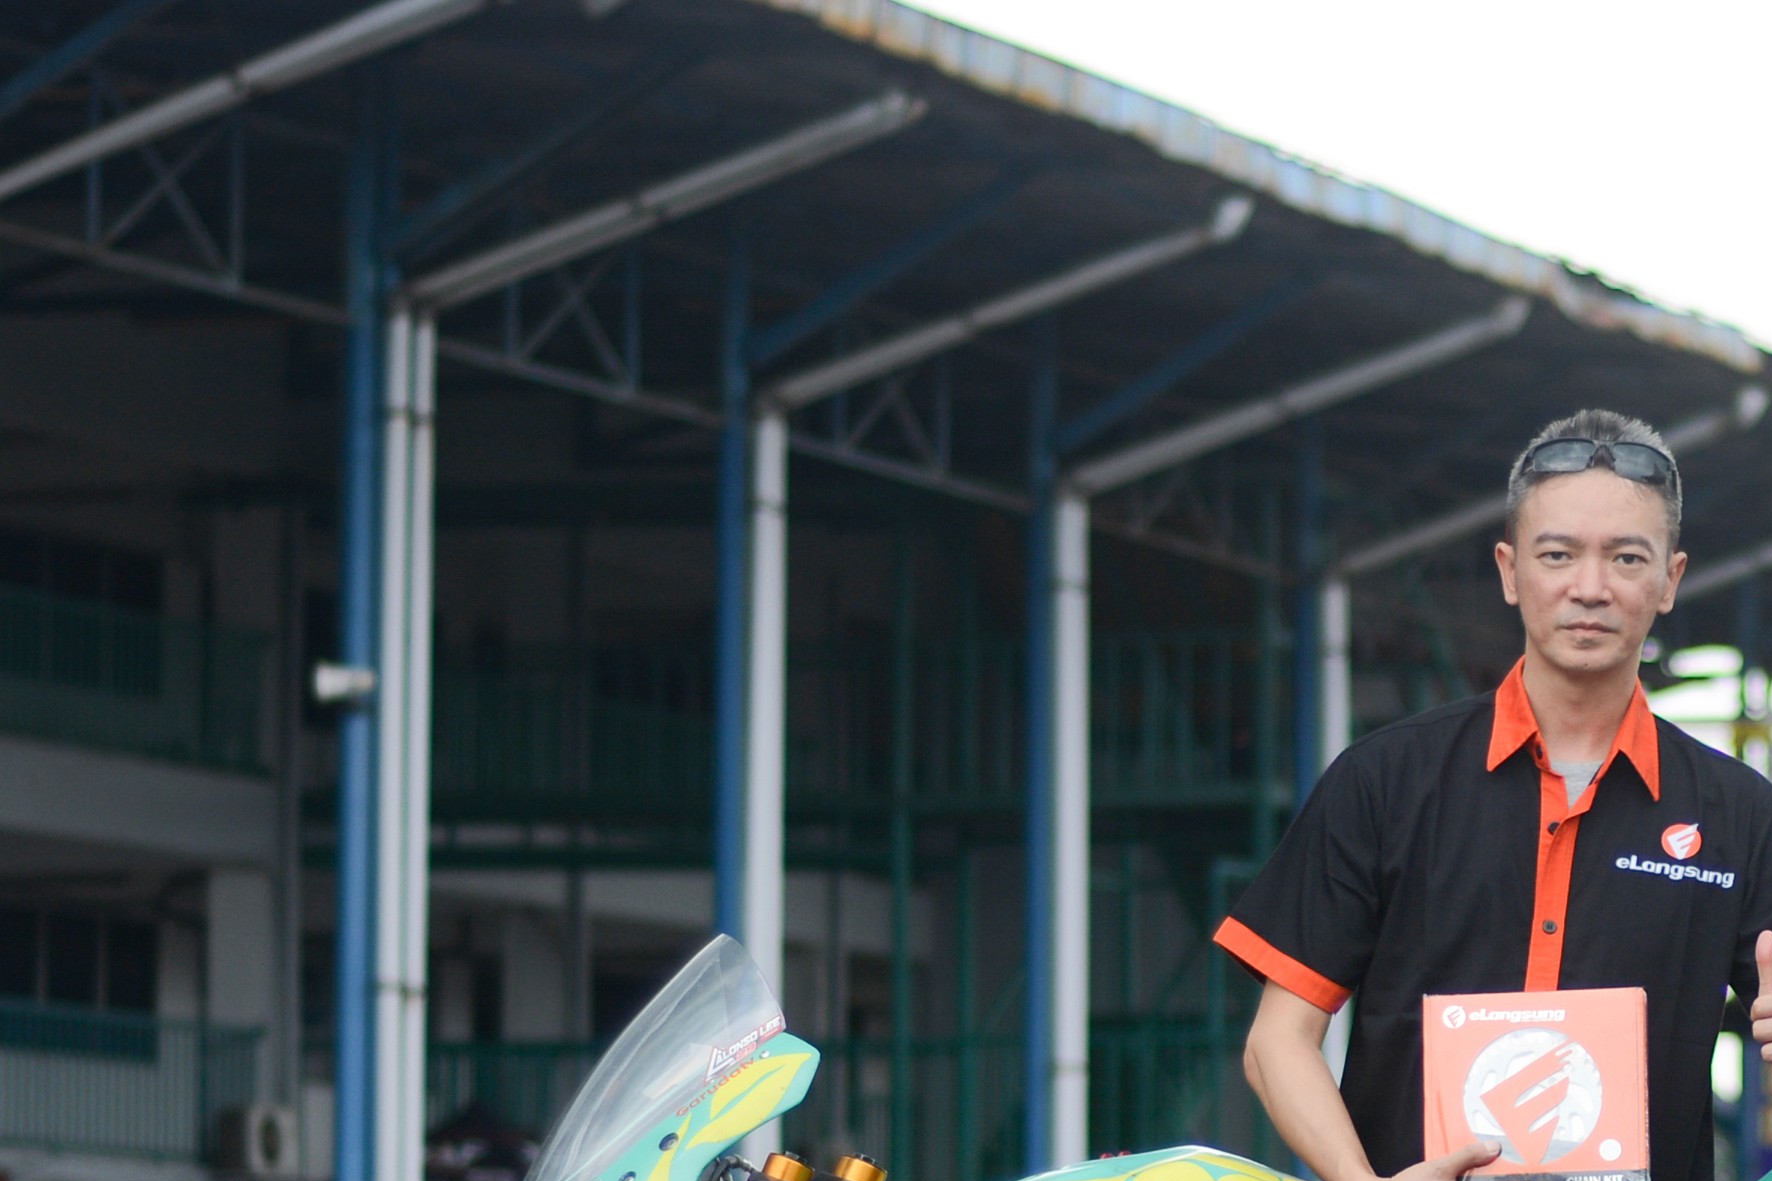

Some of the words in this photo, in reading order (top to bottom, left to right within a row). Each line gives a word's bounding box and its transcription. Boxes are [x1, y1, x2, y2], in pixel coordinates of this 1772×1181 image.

[1616, 855, 1735, 888] eLangsung
[1469, 1008, 1566, 1022] eLangsung
[676, 1055, 754, 1117] Garudatv
